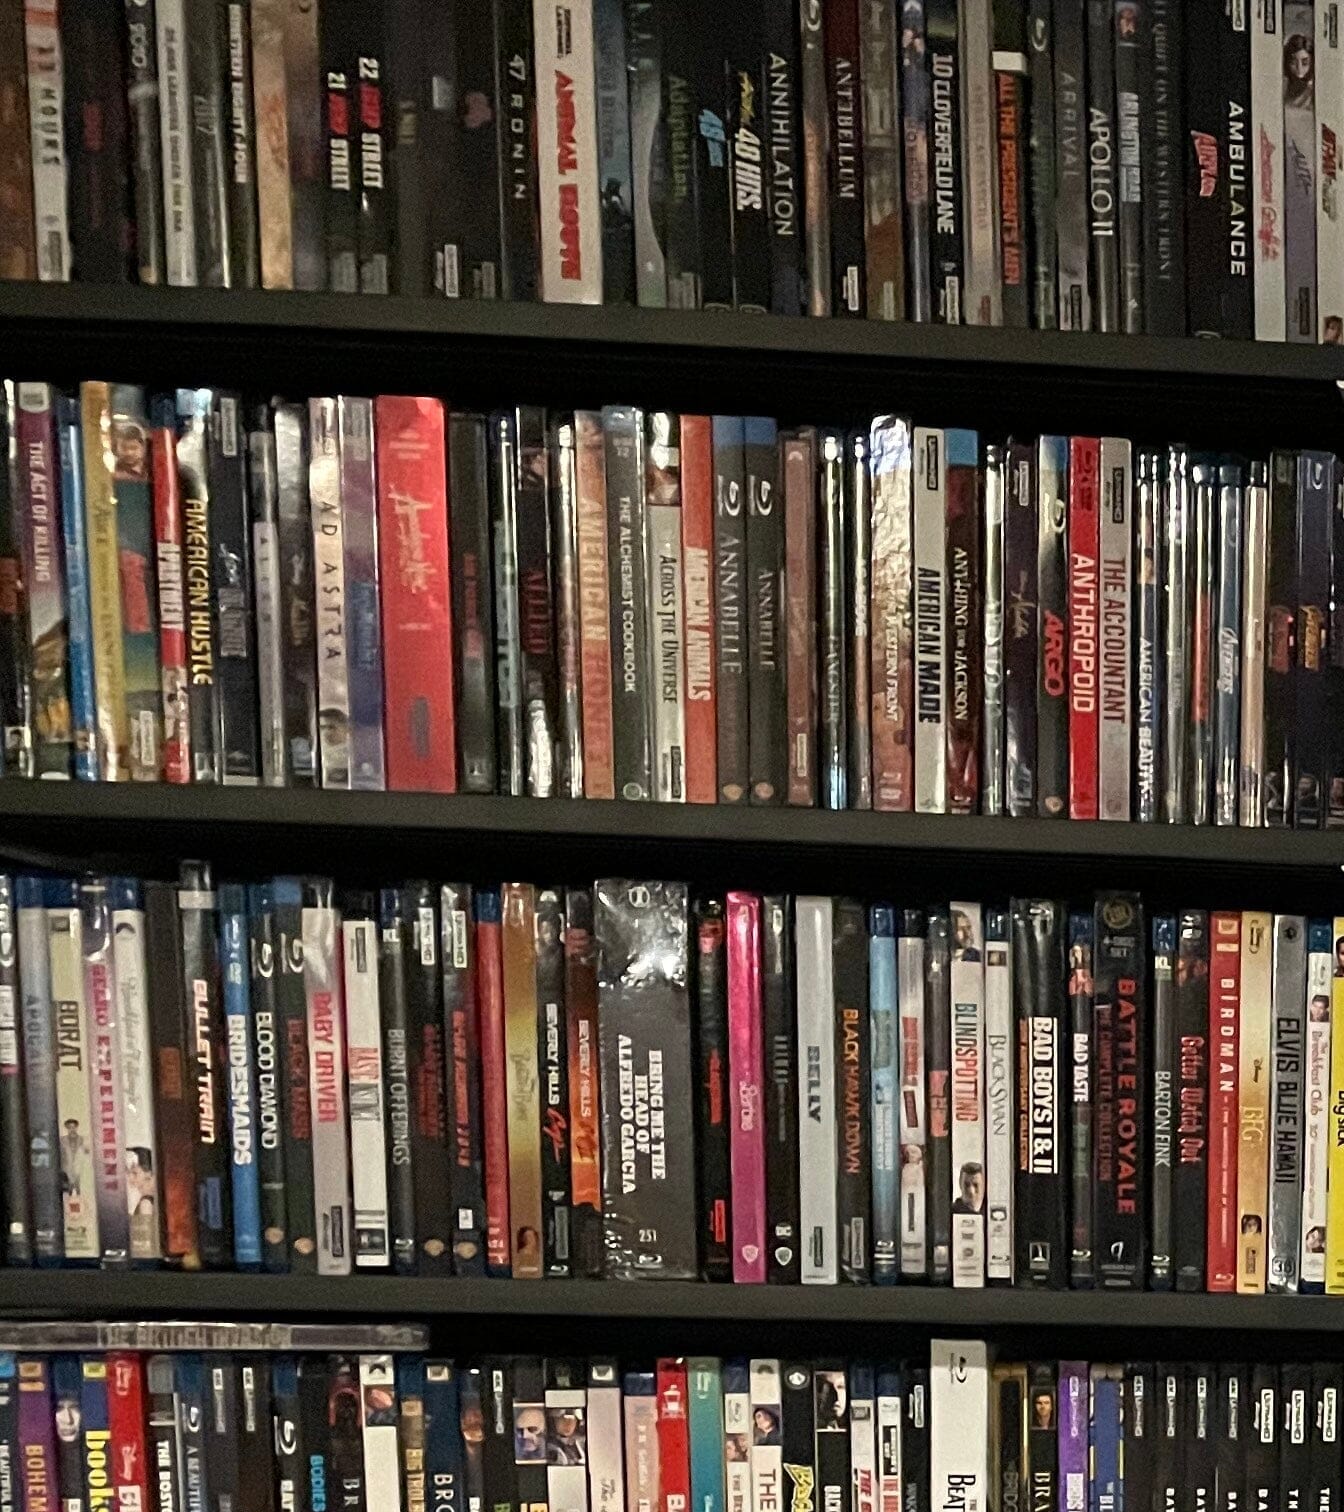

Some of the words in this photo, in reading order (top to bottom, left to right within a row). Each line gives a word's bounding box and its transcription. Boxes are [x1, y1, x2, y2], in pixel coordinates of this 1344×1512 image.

[932, 53, 953, 77] 10
[769, 53, 793, 235] ANNIHILATION
[933, 79, 953, 187] CLOVERFIELD
[936, 189, 954, 234] LANE
[1229, 102, 1246, 275] AMBULANCE
[1104, 559, 1124, 592] THE
[919, 567, 941, 655] AMERICAN
[1072, 553, 1096, 713] ANTHROPOID
[1044, 610, 1065, 695] ARGO
[1104, 597, 1126, 723] ACCOUNTANT
[919, 660, 941, 723] MADE
[954, 1003, 978, 1121] BLINDSPOTTING
[1118, 979, 1137, 1091] BATTLE
[1276, 1016, 1299, 1071] ELVIS
[228, 1014, 252, 1165] BRIDESMAIDS
[618, 1034, 635, 1120] ALFREDO
[634, 1075, 649, 1123] HEAD
[646, 1049, 663, 1105] BRING
[1276, 1081, 1299, 1125] BLUE
[634, 1129, 649, 1152] OF
[649, 1110, 664, 1136] ME
[620, 1124, 637, 1194] GARCIA
[649, 1141, 666, 1180] THE
[1118, 1100, 1138, 1213] ROYALE
[1275, 1131, 1299, 1184] HAWAII
[760, 1470, 778, 1510] THE
